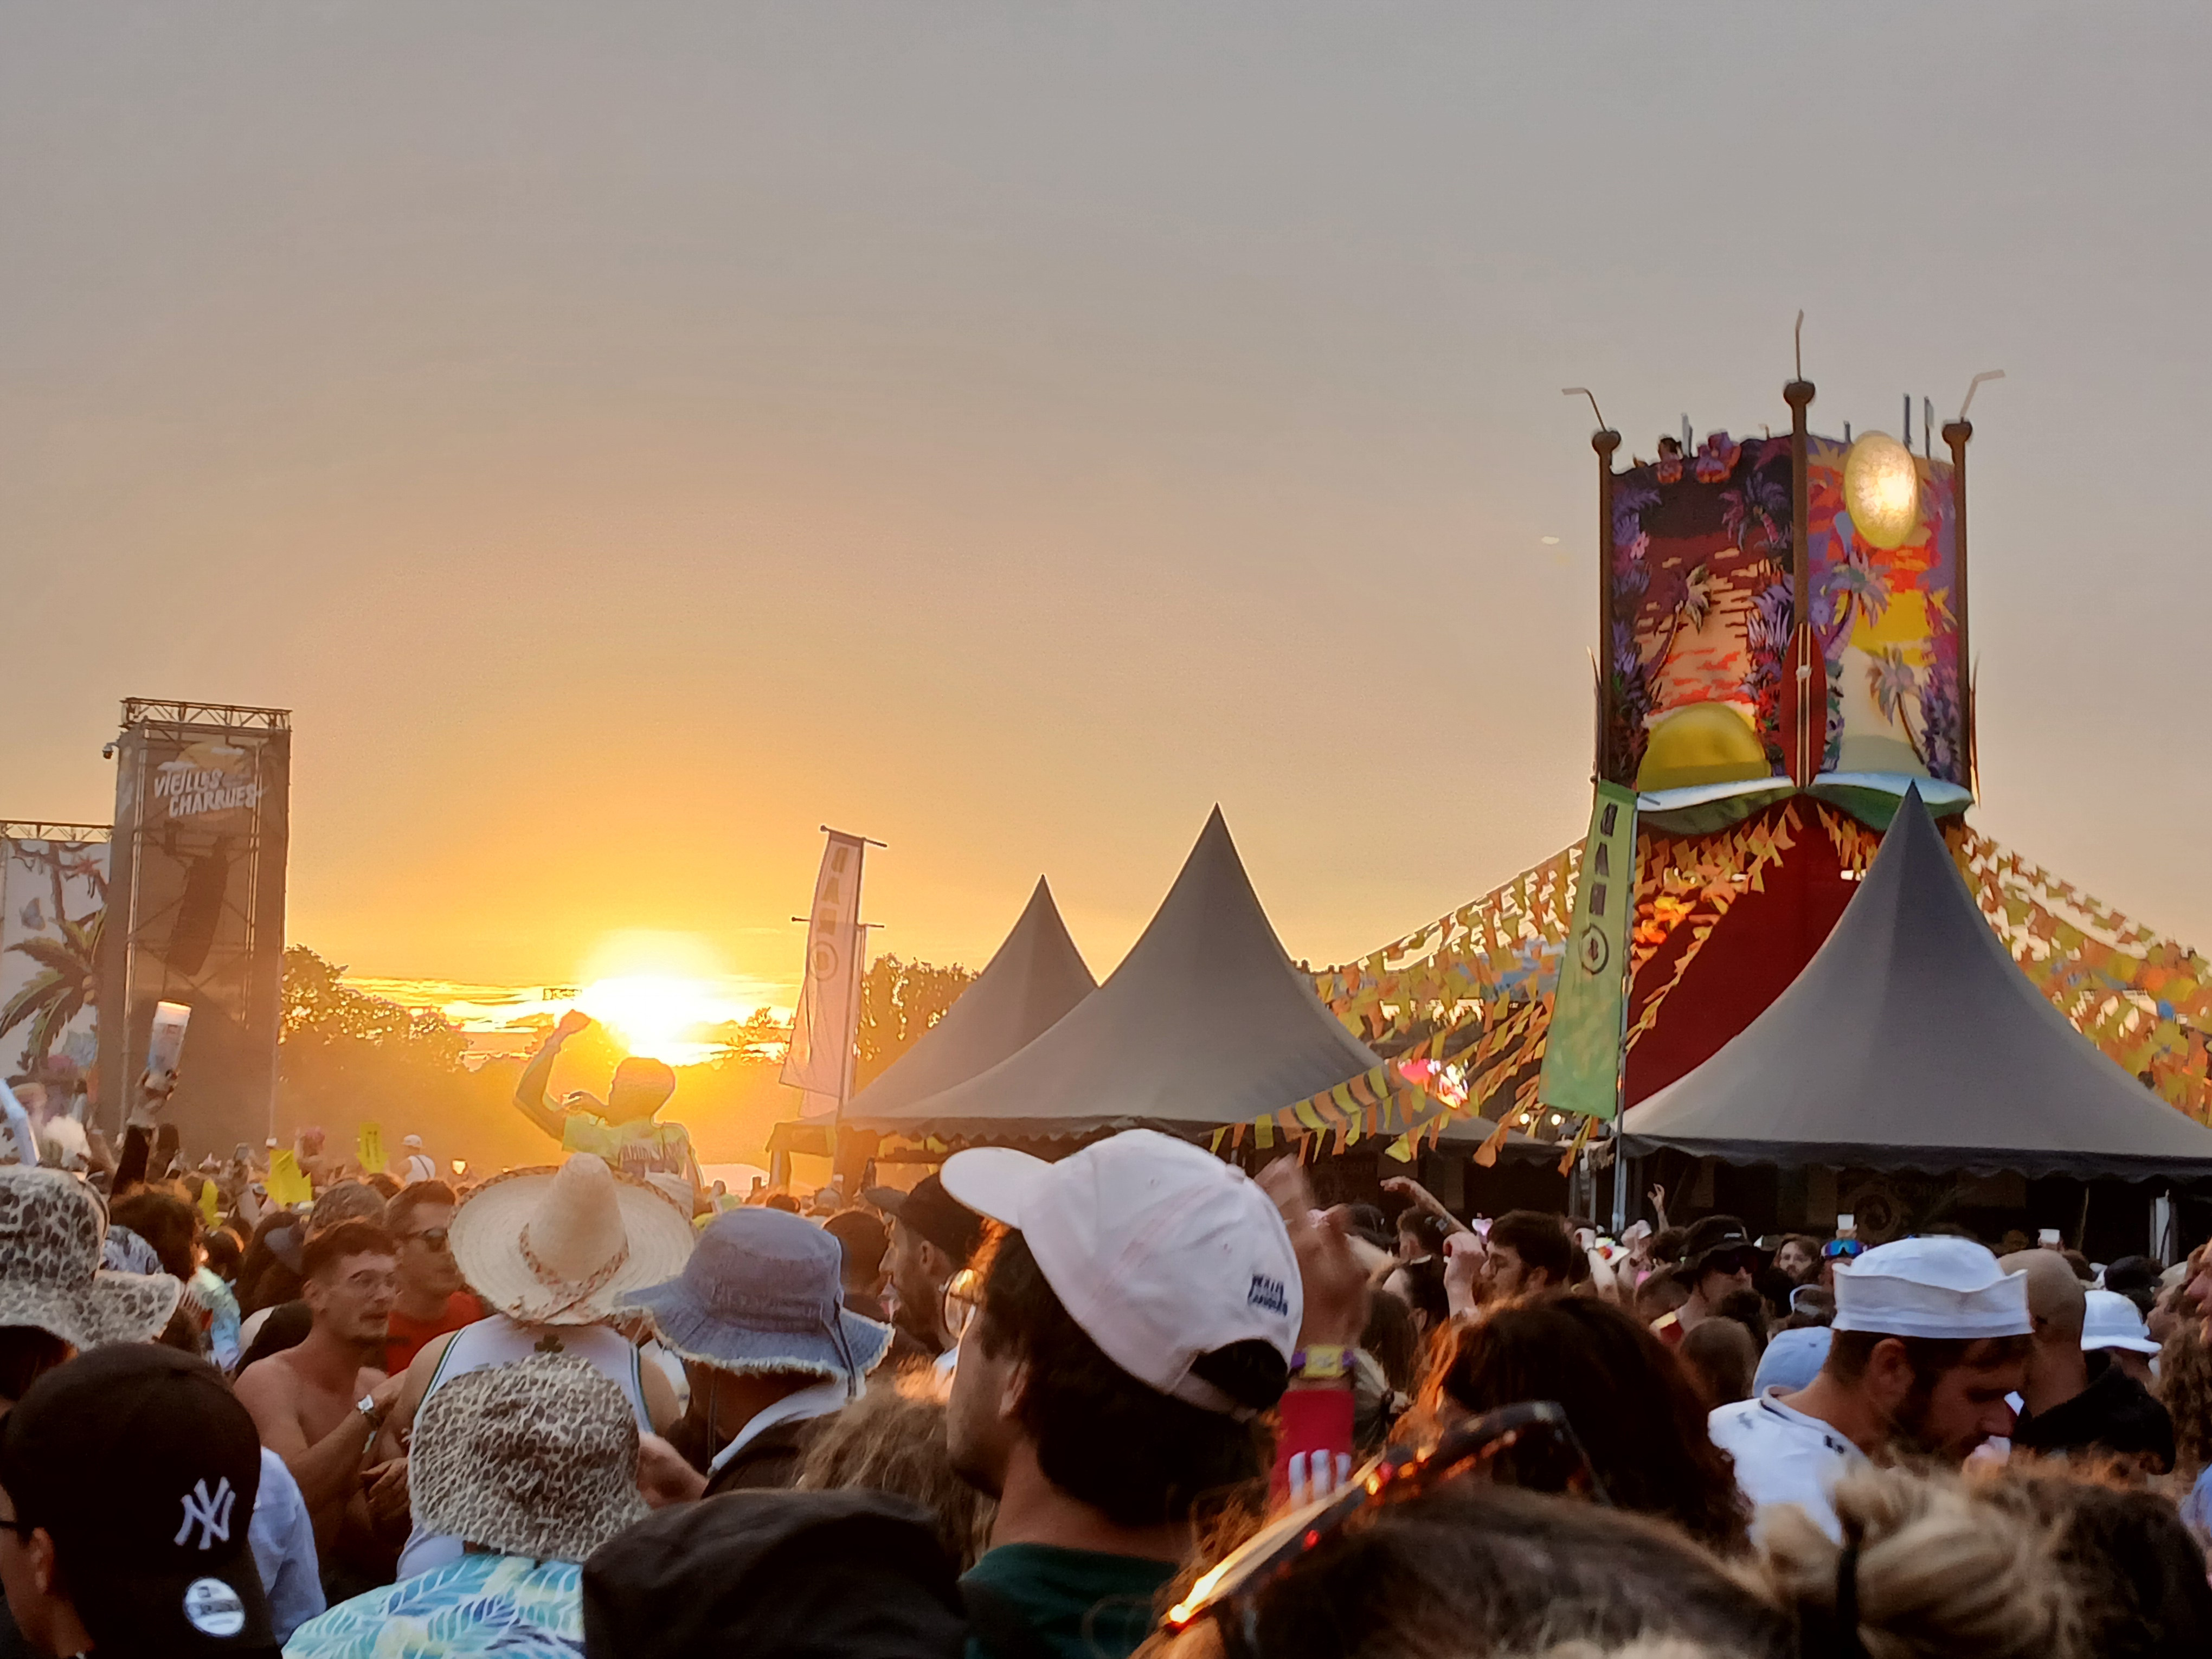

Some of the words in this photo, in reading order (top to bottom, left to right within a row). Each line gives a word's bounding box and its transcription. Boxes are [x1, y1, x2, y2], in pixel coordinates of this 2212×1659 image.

[154, 768, 223, 799] VIEILLES
[169, 783, 256, 818] CHARRUES
[173, 1476, 236, 1550] NY
